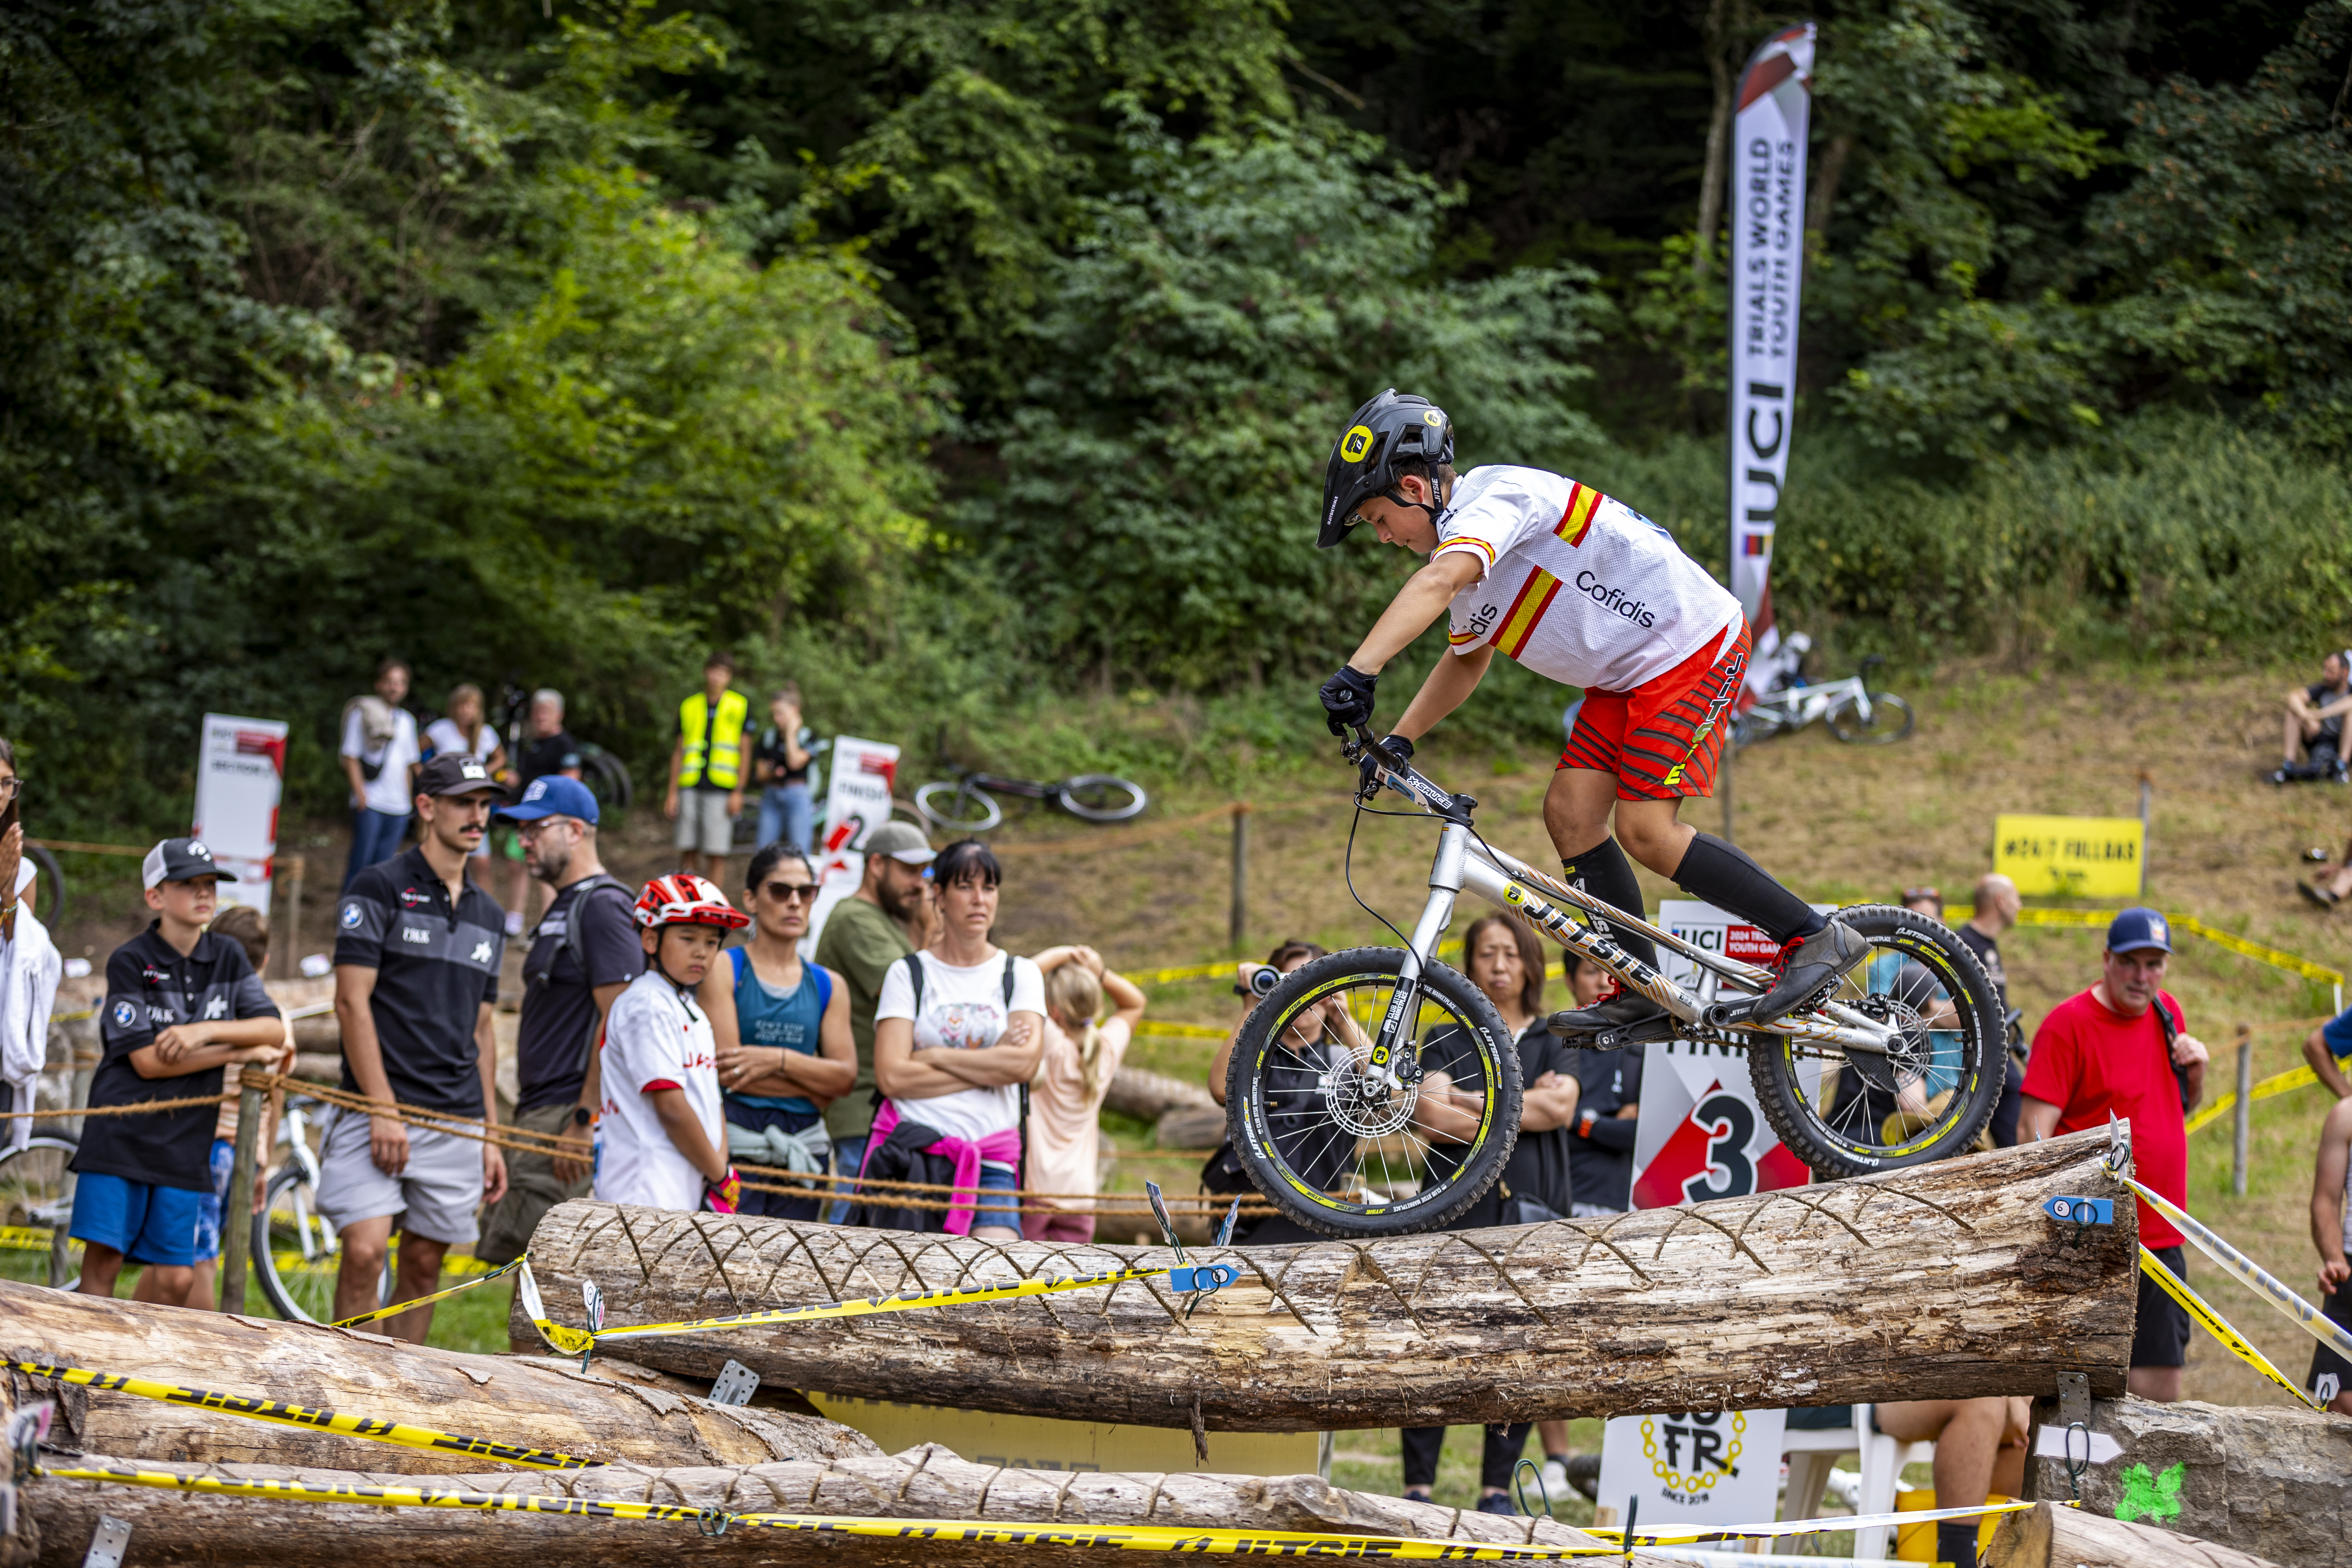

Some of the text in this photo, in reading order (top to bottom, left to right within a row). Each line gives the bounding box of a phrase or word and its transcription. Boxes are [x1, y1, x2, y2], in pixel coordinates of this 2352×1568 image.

[1748, 137, 1773, 359] TRIALS WORLD
[1770, 139, 1795, 359] YOUTH GAMES
[1747, 381, 1784, 522] UCI
[1575, 571, 1655, 629] Cofidis
[1407, 776, 1453, 809] X-SAUCE
[1729, 931, 1749, 941] 2024
[1729, 942, 1758, 952] YOUTH
[1394, 991, 1408, 1021] MARKETPLACE
[1432, 989, 1457, 1010] MARKETPLACE
[1687, 1096, 1755, 1204] 3
[1393, 1198, 1421, 1212] MARKETPLACE
[2057, 1203, 2064, 1212] 6
[1663, 1424, 1739, 1479] FR
